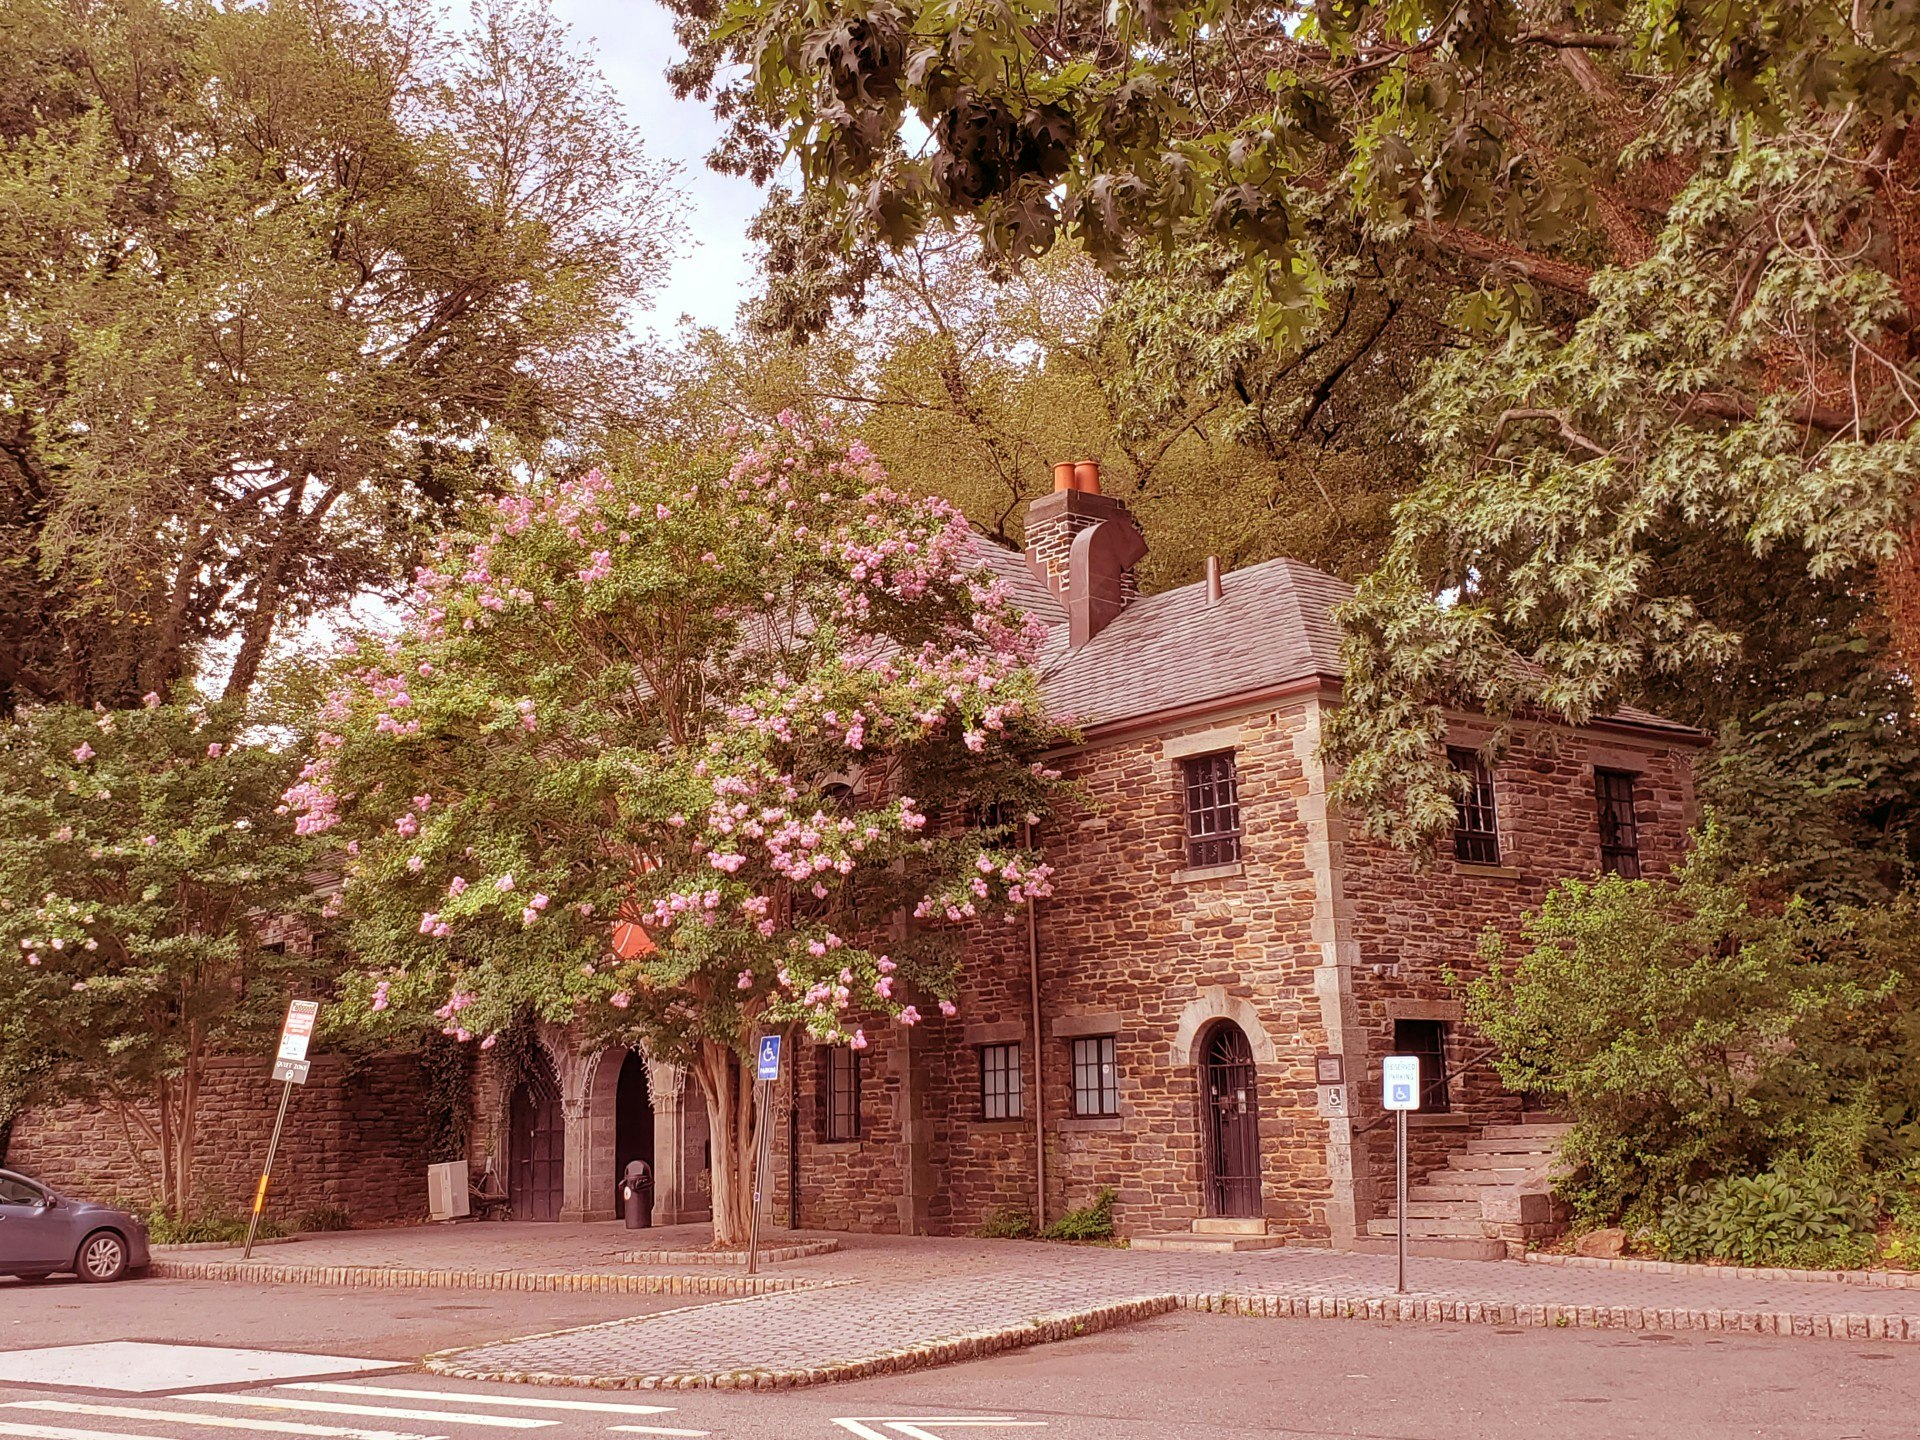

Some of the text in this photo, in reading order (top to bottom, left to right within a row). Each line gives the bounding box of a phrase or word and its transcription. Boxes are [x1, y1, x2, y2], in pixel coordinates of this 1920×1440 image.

[276, 1060, 307, 1071] QUIET ZONE
[760, 1066, 776, 1074] PARKING
